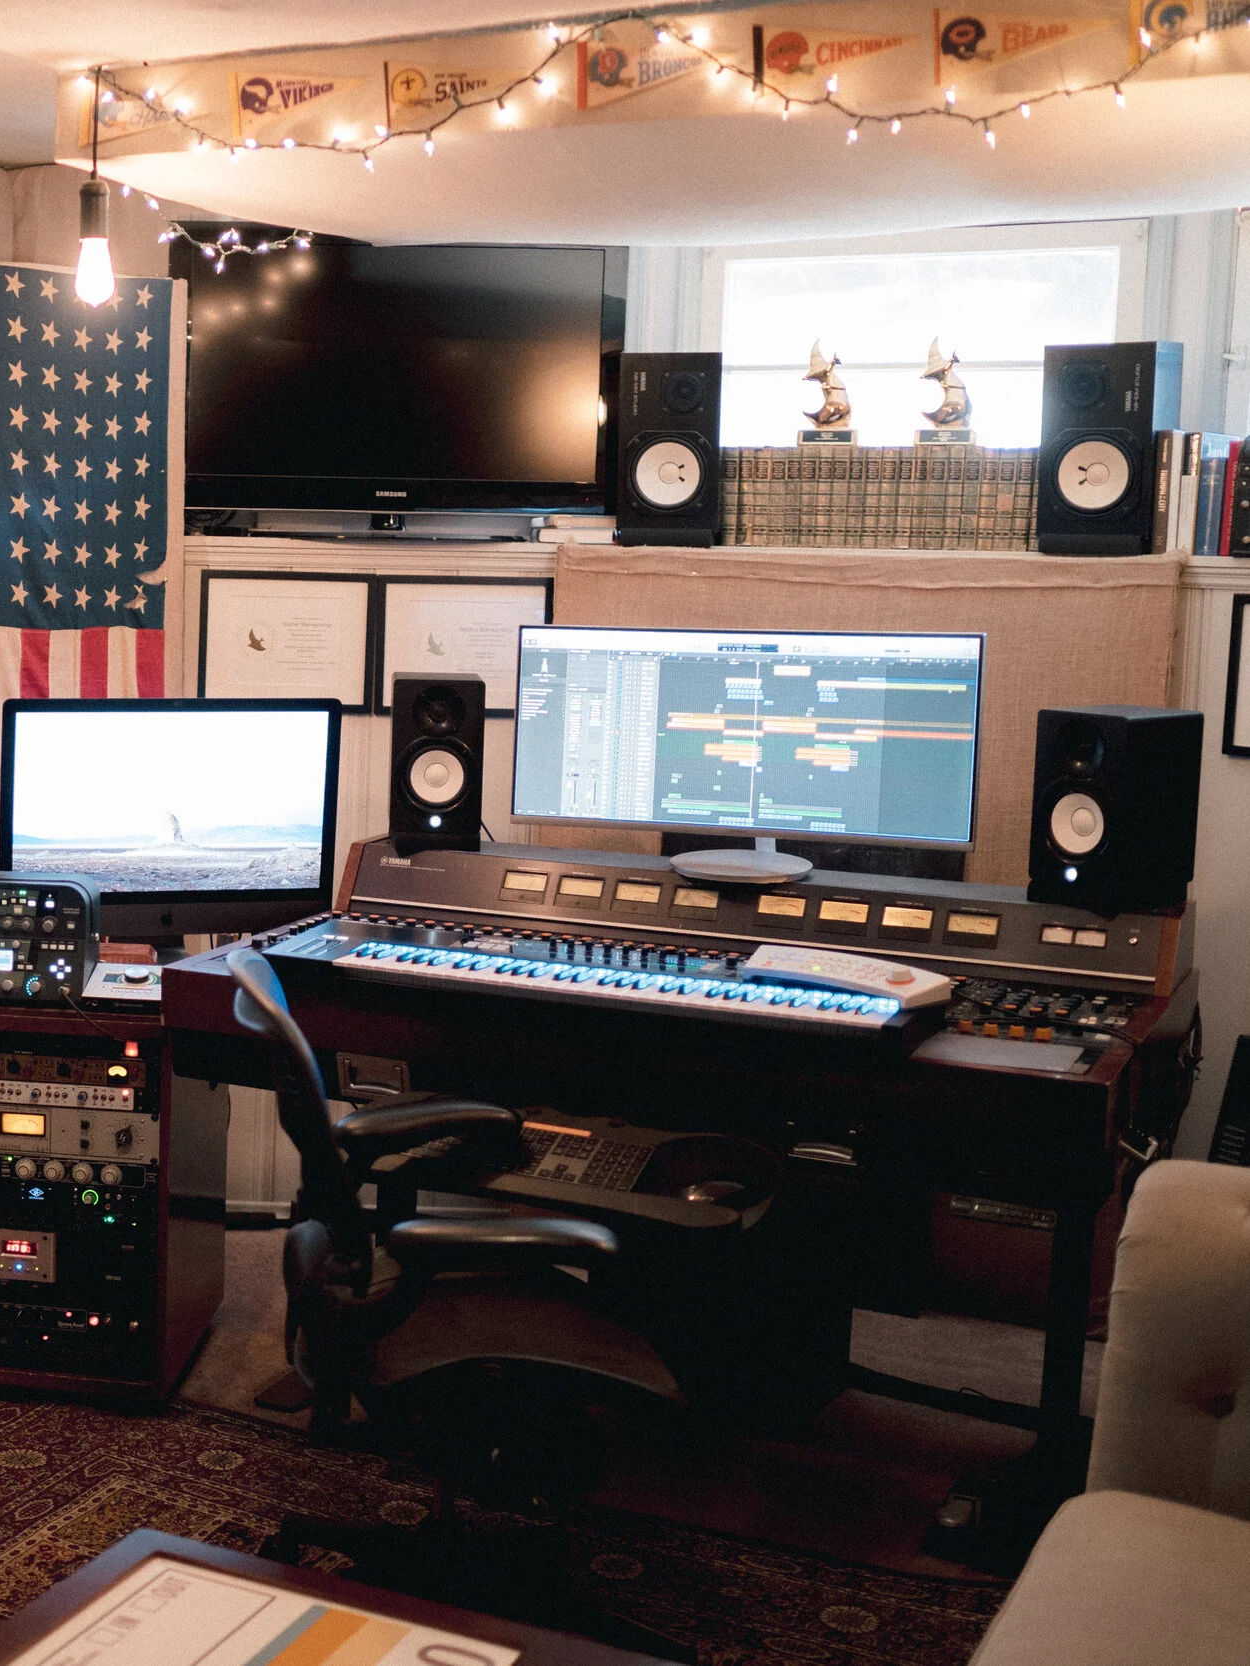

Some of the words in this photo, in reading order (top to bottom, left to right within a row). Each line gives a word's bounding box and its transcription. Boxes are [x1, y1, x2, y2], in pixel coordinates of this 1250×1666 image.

[815, 37, 903, 66] CINCINNATI
[1002, 24, 1068, 53] BEARS
[638, 57, 702, 86] BRONCOS
[279, 81, 334, 109] VIKINGS
[435, 78, 487, 104] SAINTS
[375, 490, 407, 498] SAMSUNG
[388, 857, 411, 867] YAMAHA
